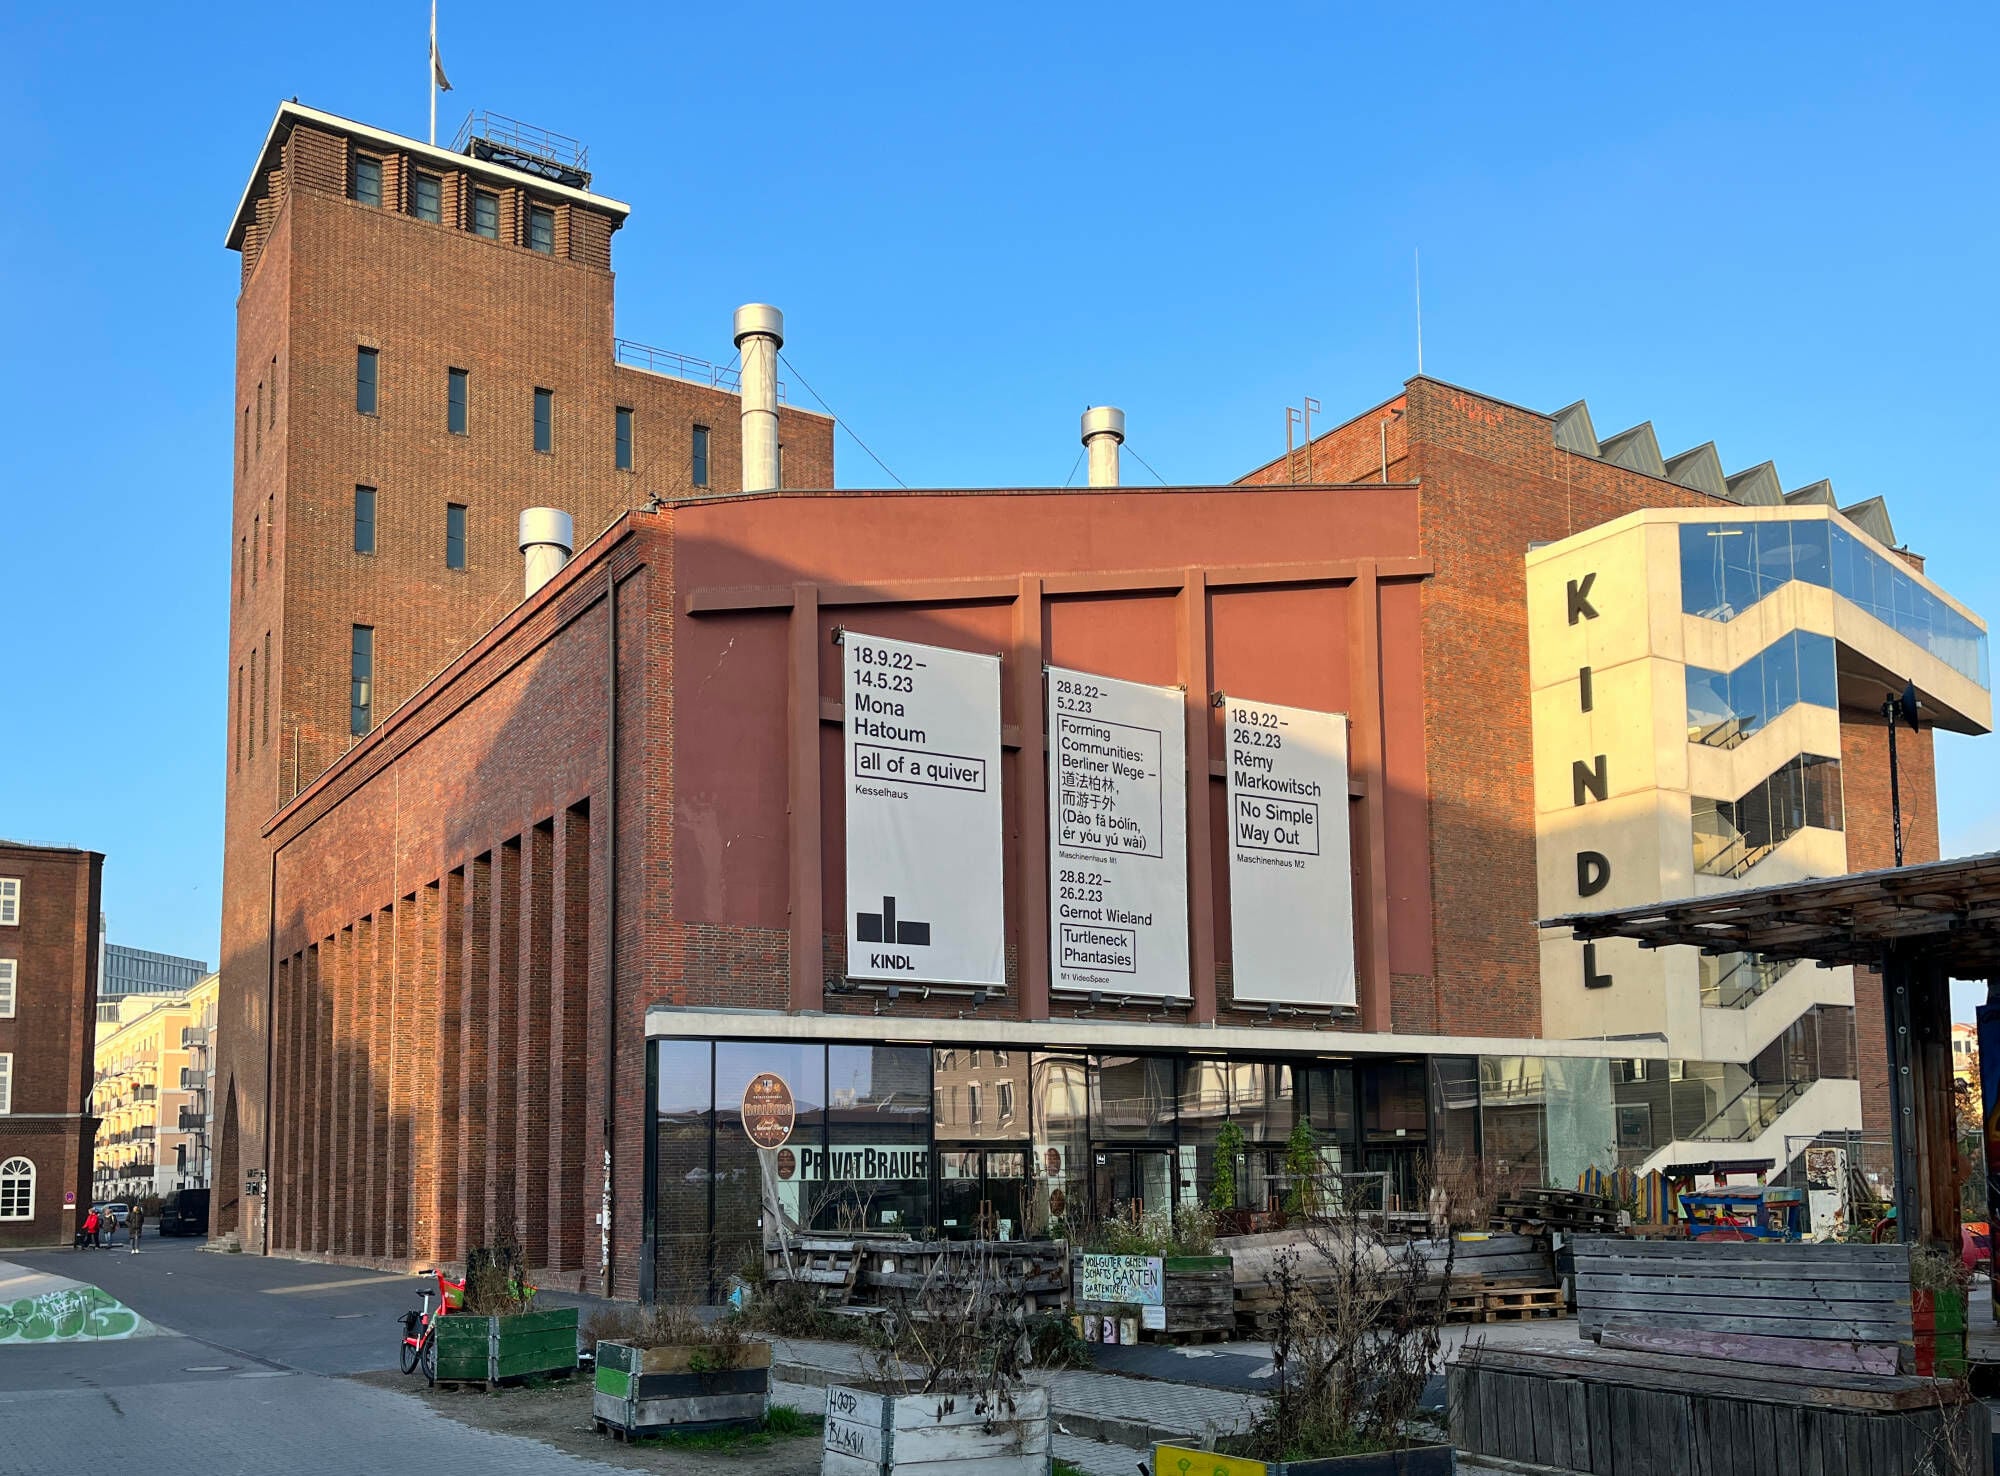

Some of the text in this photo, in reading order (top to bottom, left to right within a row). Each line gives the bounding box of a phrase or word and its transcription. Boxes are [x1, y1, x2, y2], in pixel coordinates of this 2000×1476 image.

[853, 669, 913, 693] 14.5.23
[855, 692, 905, 717] Mona
[1057, 696, 1092, 713] 5.2.23
[855, 716, 926, 743] Hatoum
[1061, 719, 1111, 742] Forming
[1233, 728, 1281, 749] 26.2.23
[1061, 736, 1144, 762] Communities:
[860, 752, 980, 782] all of a quiver
[1062, 753, 1109, 773] Berliner
[1112, 761, 1145, 781] Wege
[1234, 749, 1274, 773] Rémy
[1234, 770, 1321, 797] Markowitsch
[1566, 571, 1613, 989] KINDL
[855, 784, 909, 800] Kesselhaus
[1240, 800, 1314, 825] No Simple
[1240, 822, 1300, 845] Way Out
[1236, 853, 1305, 869] Maschinenhaus M2
[1059, 886, 1103, 903] 26.2.23
[1059, 903, 1153, 926] Gernot Wieland
[1063, 928, 1128, 948] Turtleneck
[870, 953, 915, 971] KINDL
[1064, 947, 1132, 967] Phantasies
[1060, 972, 1110, 984] M1 VideoSpace
[1084, 1268, 1158, 1287] SCHAFTS GARTEN
[1085, 1284, 1128, 1295] GARTENTREFF
